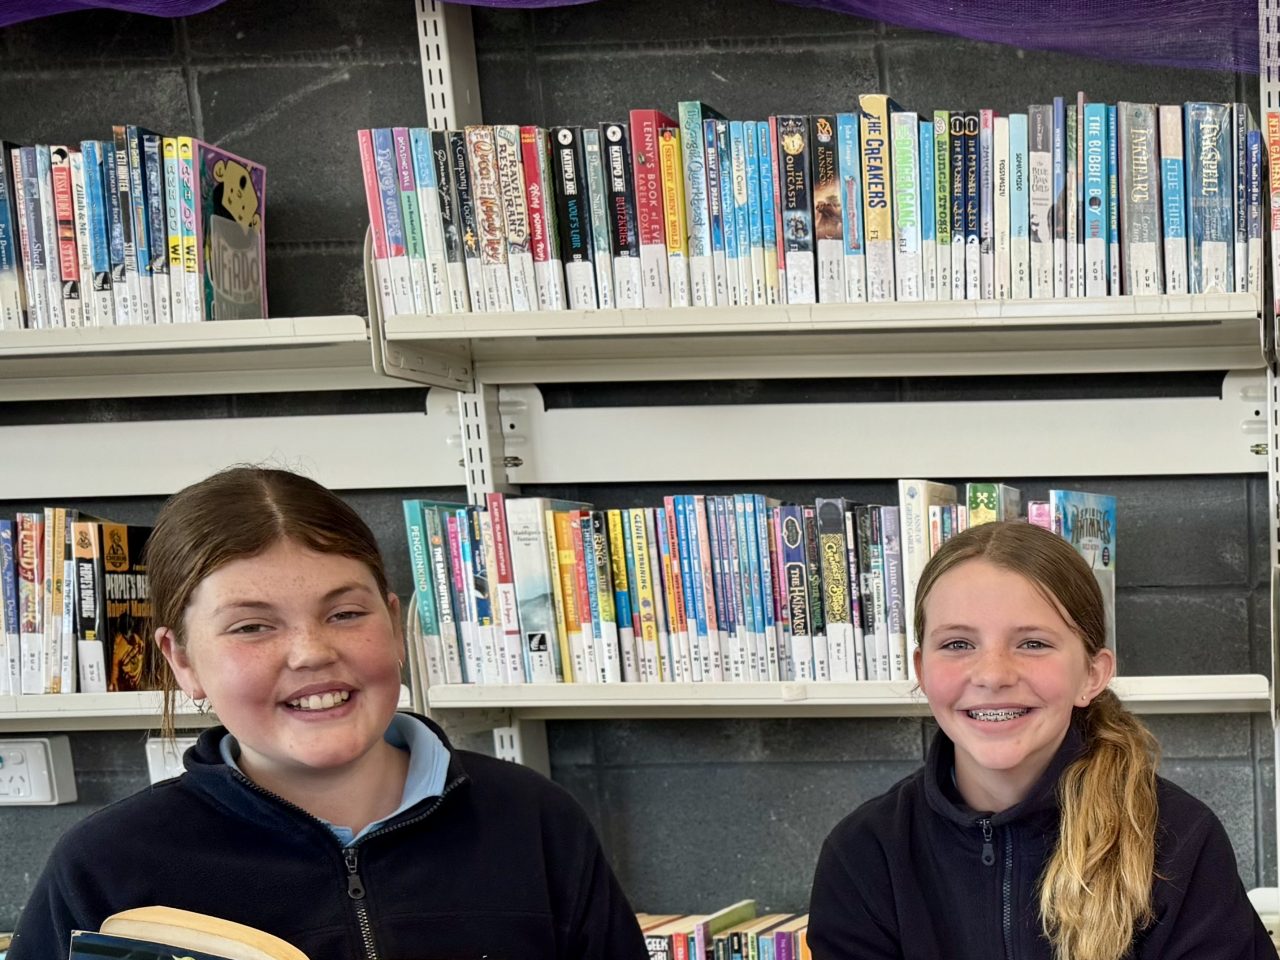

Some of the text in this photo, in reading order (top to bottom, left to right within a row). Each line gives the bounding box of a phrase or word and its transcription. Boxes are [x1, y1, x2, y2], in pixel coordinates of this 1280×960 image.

[1088, 116, 1100, 136] THE
[1269, 117, 1280, 137] NEIL
[454, 147, 468, 189] Company
[562, 150, 574, 181] KATIPO
[609, 146, 623, 176] KATIPO
[643, 121, 658, 207] LENNY'S BOOK
[864, 139, 887, 209] CREAKERS
[499, 144, 518, 235] RESTAURANT
[508, 150, 524, 238] TRAVELLING
[566, 180, 577, 196] JOE
[786, 156, 797, 208] OUTCASTS
[795, 172, 803, 191] THE
[76, 184, 84, 216] Zillah
[410, 526, 427, 592] PENGUINKIND
[889, 559, 897, 587] Anne
[790, 568, 799, 588] THE
